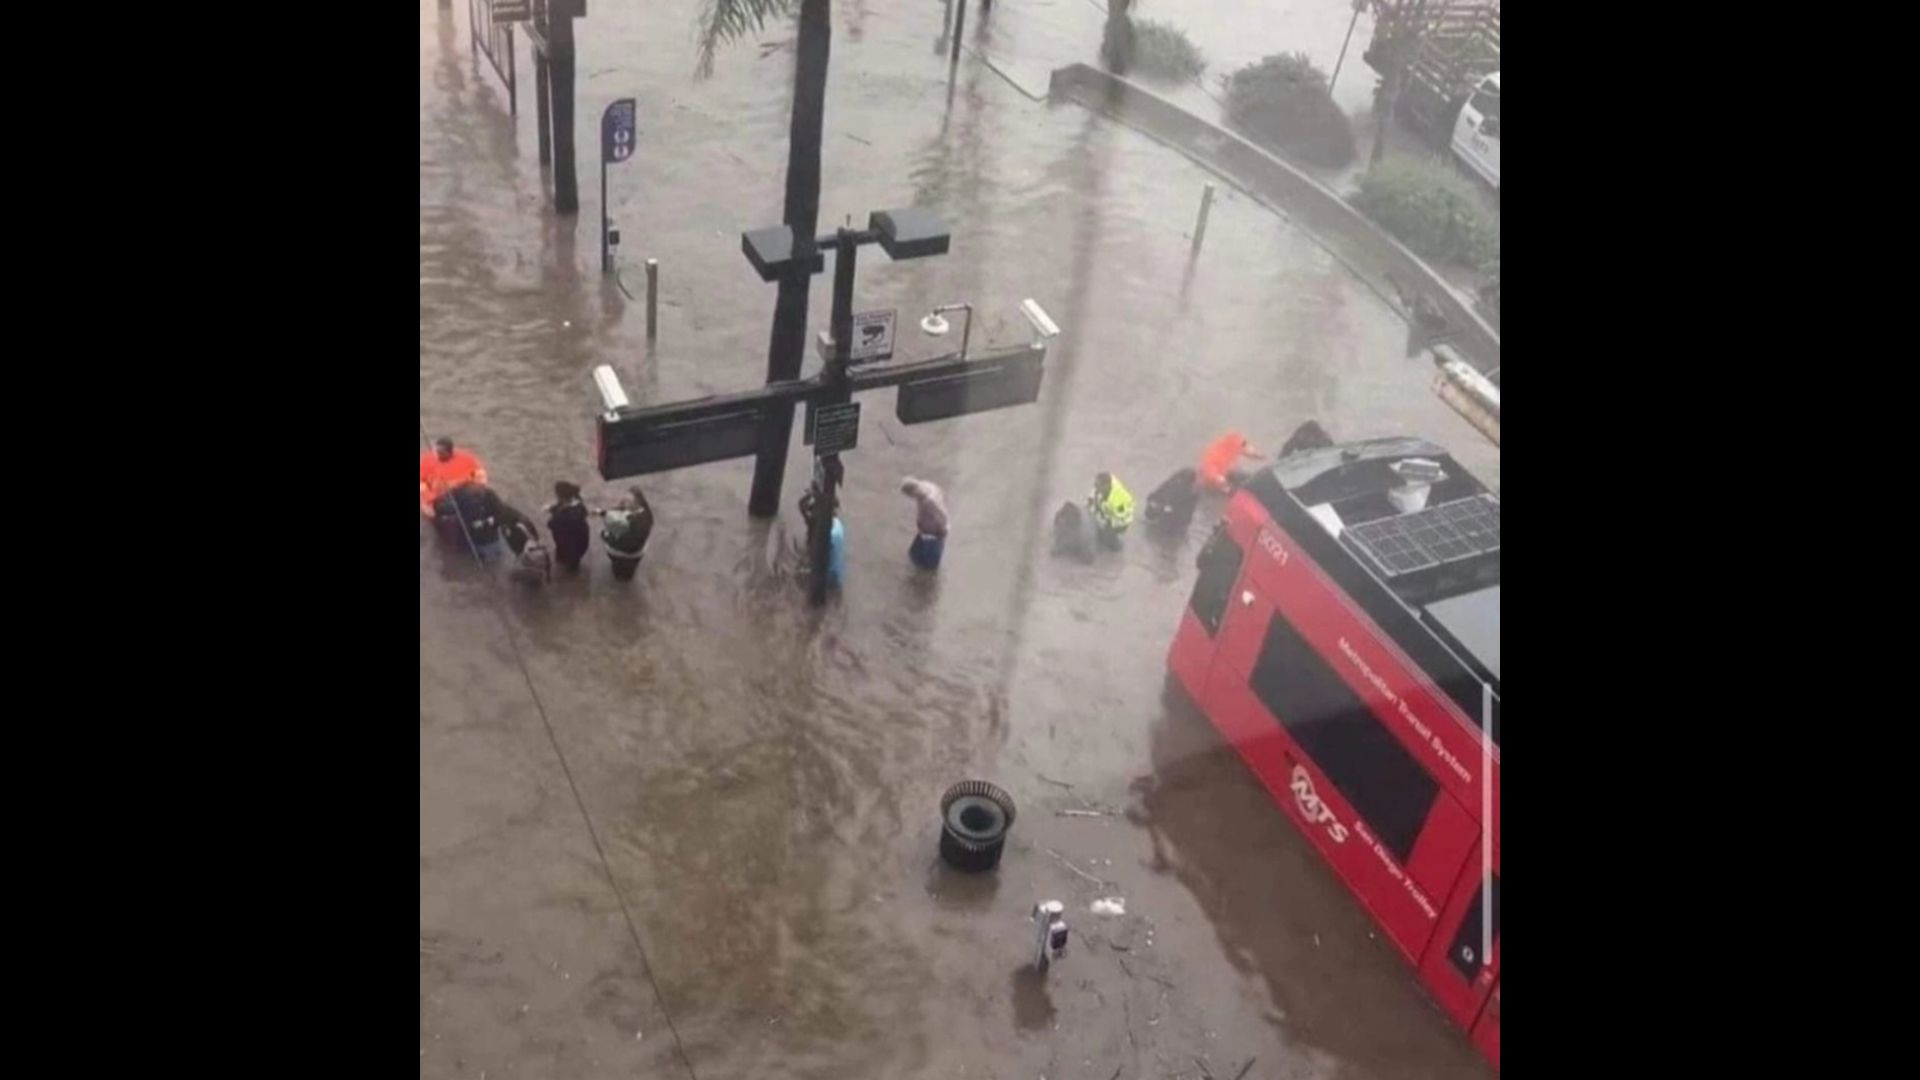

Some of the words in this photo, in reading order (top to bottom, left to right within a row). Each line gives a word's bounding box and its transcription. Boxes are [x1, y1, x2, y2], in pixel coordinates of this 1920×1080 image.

[1338, 636, 1398, 704] Metropolitan
[1398, 699, 1431, 740] Transit
[1431, 736, 1472, 783] System
[1289, 779, 1349, 844] MTS
[1354, 820, 1375, 845] San
[1374, 843, 1403, 879] Diego
[1403, 875, 1438, 919] Trolley
